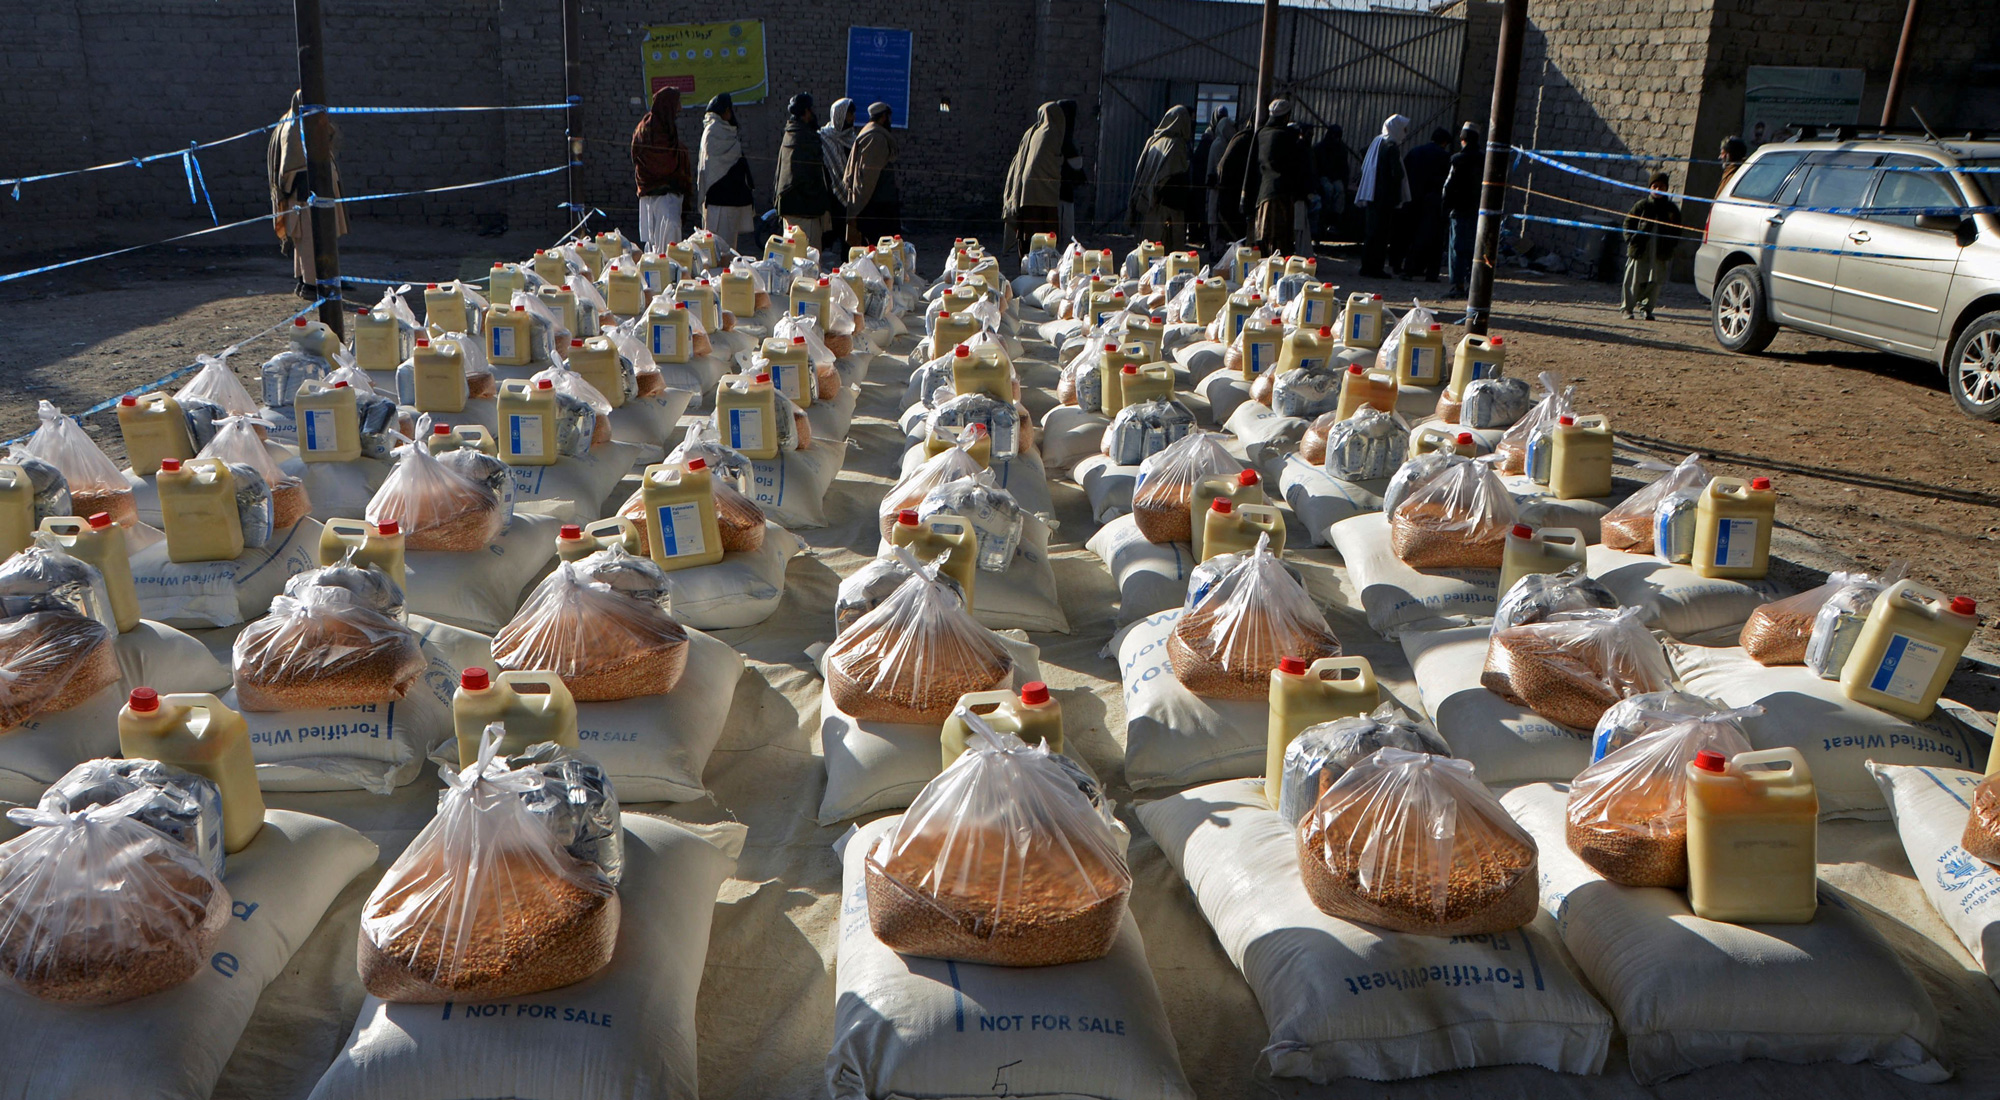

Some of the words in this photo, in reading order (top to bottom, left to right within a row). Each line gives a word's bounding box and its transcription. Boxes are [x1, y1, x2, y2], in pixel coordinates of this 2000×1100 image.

[183, 569, 236, 586] Fortified
[1443, 592, 1497, 603] ortified
[1909, 641, 1938, 653] Palmolein
[298, 723, 379, 743] Fortified
[577, 729, 599, 741] OR
[603, 731, 638, 742] SALE
[1823, 734, 1886, 751] Wheat
[1890, 734, 1963, 764] Fortified
[1937, 844, 1959, 864] WFP
[1959, 882, 1988, 908] World
[465, 1003, 511, 1019] NOT
[516, 1003, 557, 1020] FOR
[563, 1007, 612, 1028] SALE
[980, 1015, 1024, 1032] NOT
[1032, 1014, 1072, 1031] FOR
[1078, 1015, 1125, 1036] SALE
